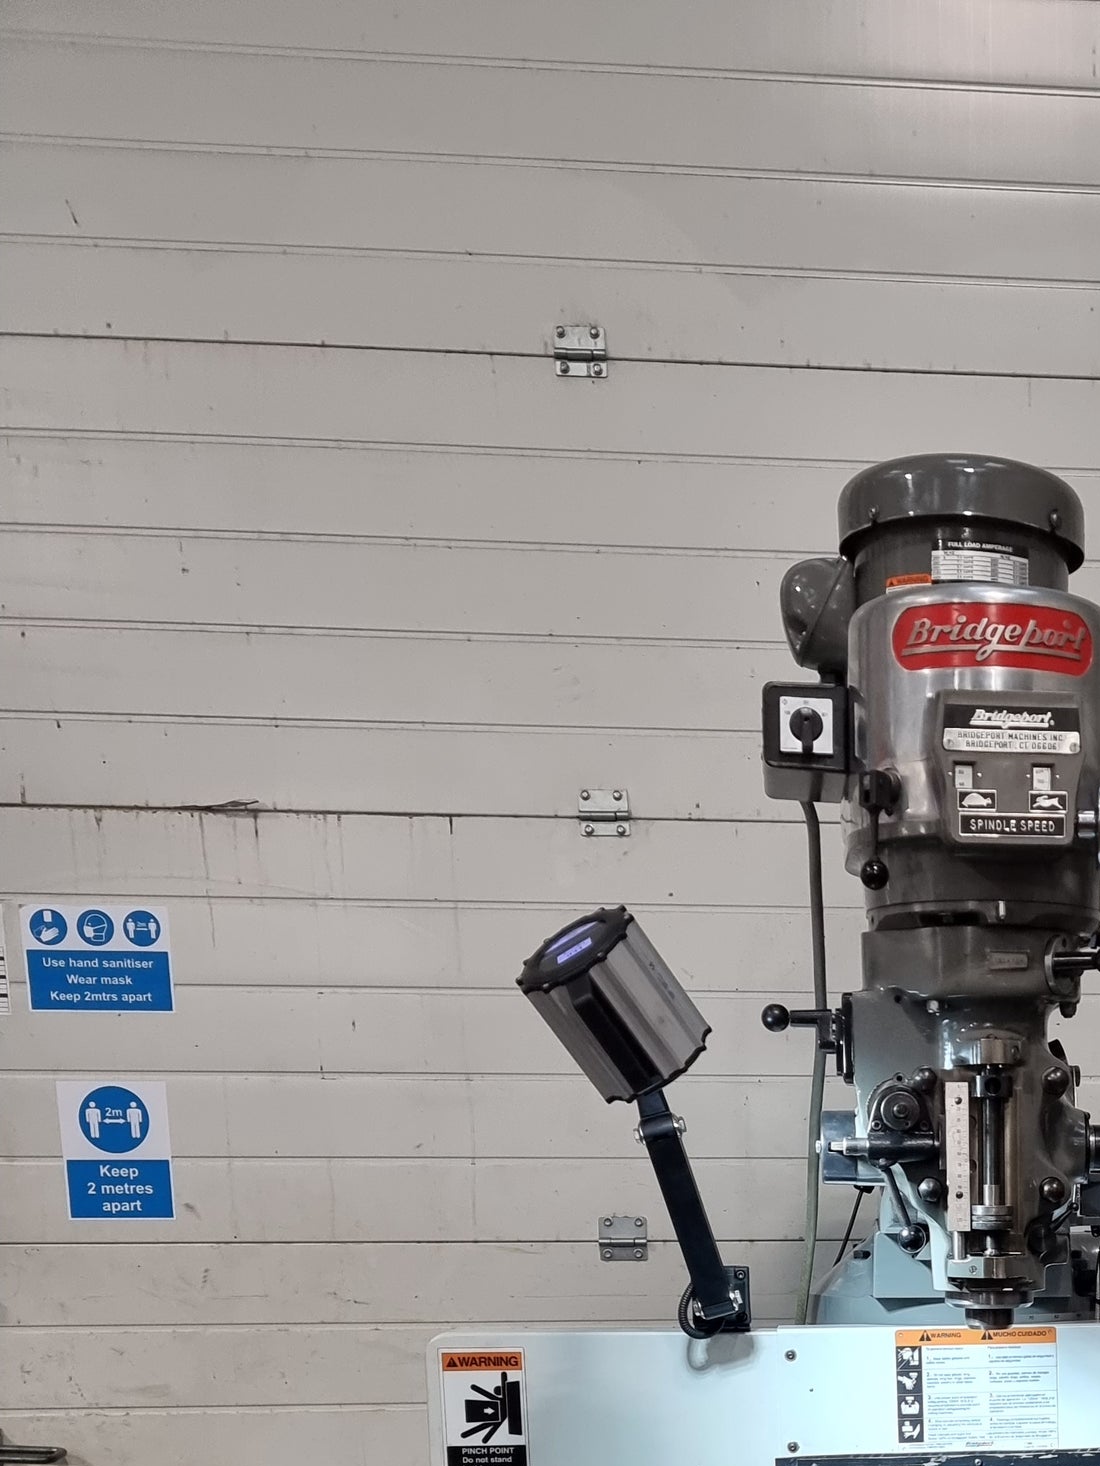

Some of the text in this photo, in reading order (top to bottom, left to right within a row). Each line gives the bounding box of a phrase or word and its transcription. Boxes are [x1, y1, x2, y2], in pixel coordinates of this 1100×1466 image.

[982, 543, 1014, 552] AMPERAGE
[905, 615, 1087, 661] Bridgeport
[970, 708, 1052, 728] Bridgeport
[958, 731, 1005, 740] BRIDGEPORT
[1008, 732, 1046, 741] MACHINES
[1032, 742, 1057, 750] 06606
[970, 819, 1055, 832] SPINDLE SPEED
[42, 957, 154, 968] Use hand sanitiser
[66, 974, 133, 985] Wear mask
[50, 991, 152, 1003] Keep 2mtrs apart
[104, 1107, 123, 1116] 2m
[100, 1165, 139, 1180] Keep
[87, 1183, 153, 1194] 2 metres
[102, 1200, 142, 1214] apart
[458, 1356, 518, 1367] WARNING
